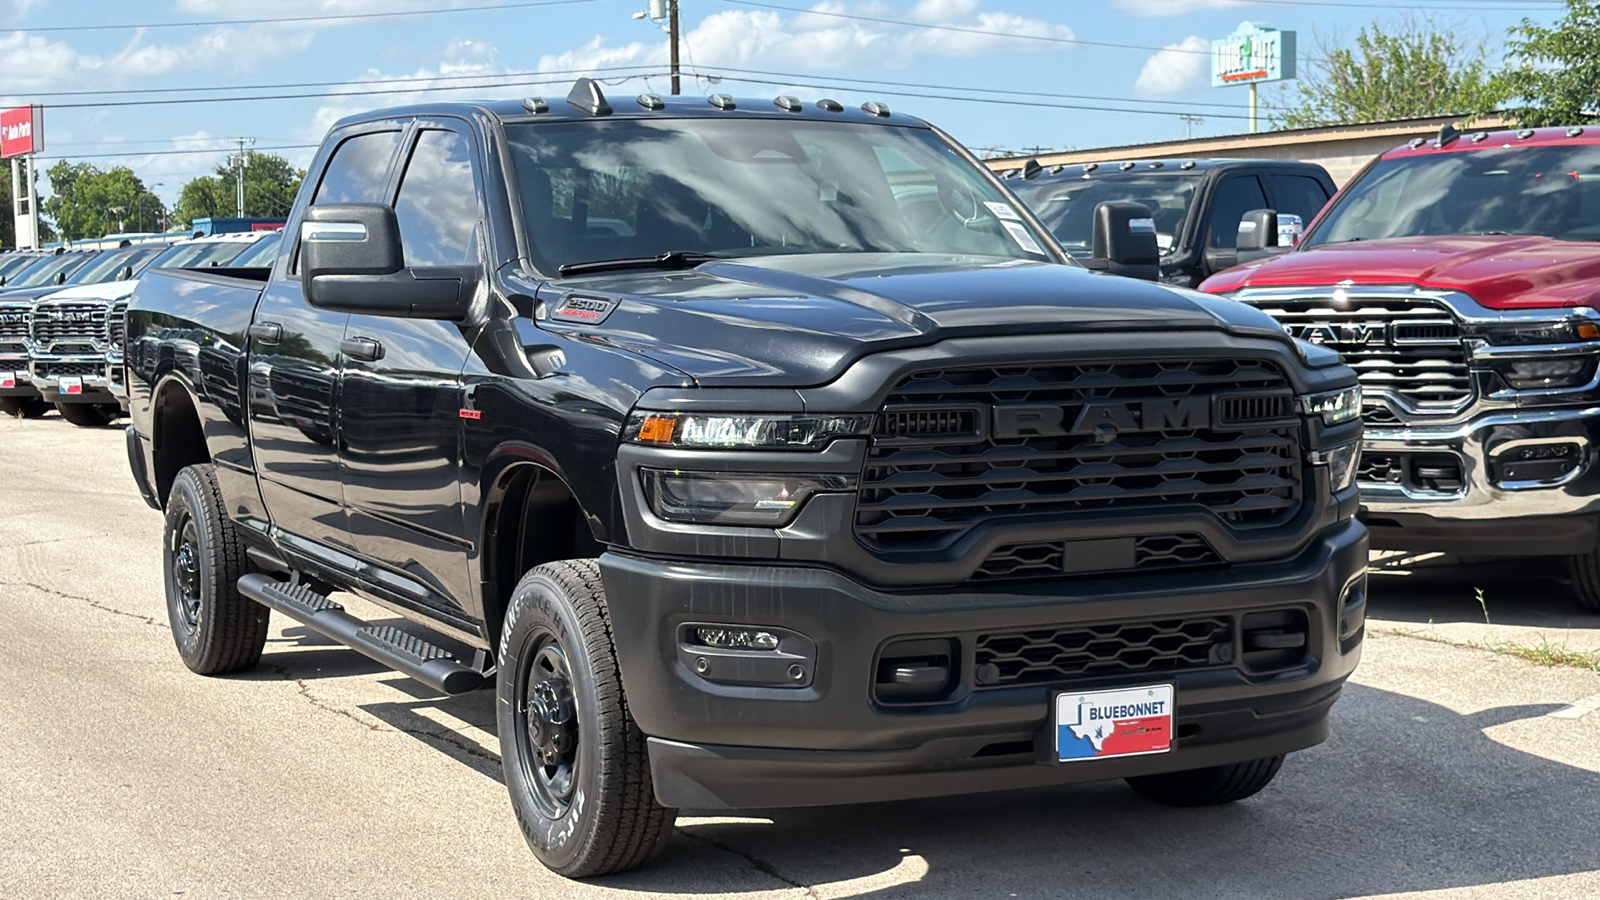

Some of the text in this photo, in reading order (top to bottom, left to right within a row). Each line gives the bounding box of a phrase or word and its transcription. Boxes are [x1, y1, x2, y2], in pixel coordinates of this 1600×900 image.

[567, 299, 608, 313] 2500
[0, 313, 21, 322] AM
[993, 396, 1210, 440] RAM
[1089, 701, 1165, 720] BLUEBONNET
